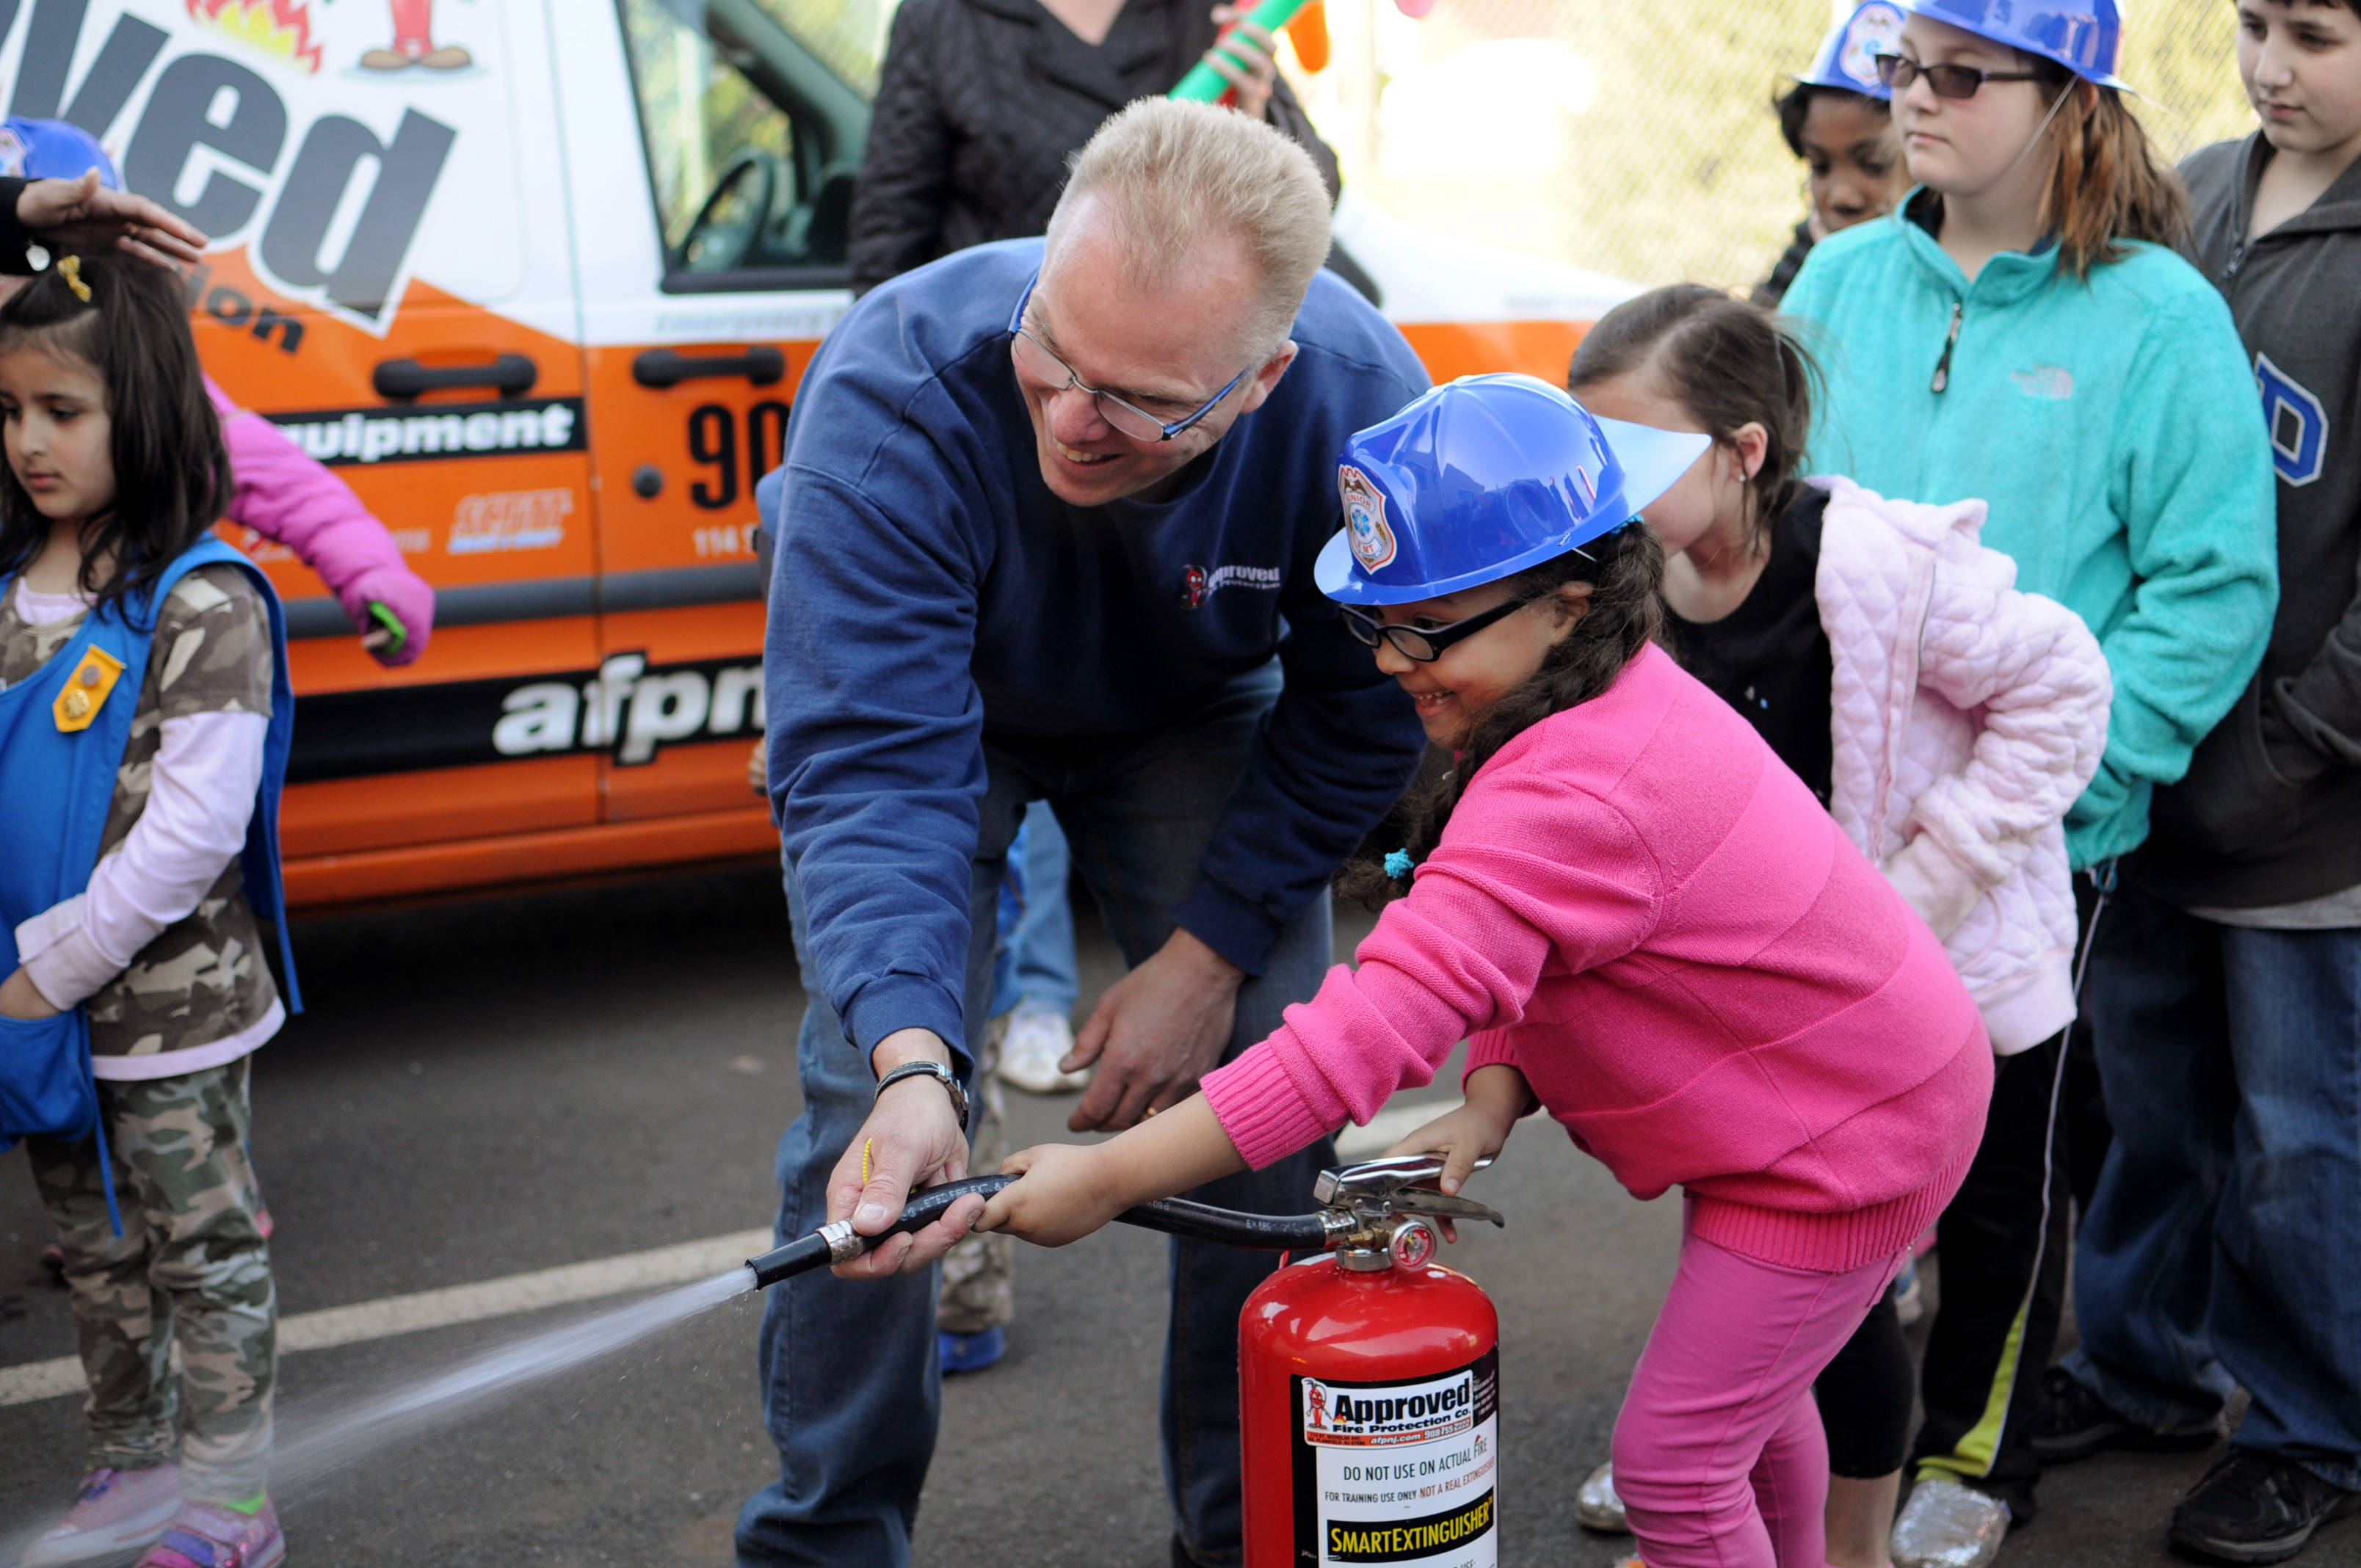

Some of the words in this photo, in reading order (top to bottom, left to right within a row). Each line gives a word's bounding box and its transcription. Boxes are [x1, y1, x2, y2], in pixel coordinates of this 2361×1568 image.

[0, 0, 458, 320] ved
[176, 260, 305, 354] ion
[1332, 1377, 1470, 1424] Approved
[1332, 1424, 1364, 1434] Fire
[1369, 1415, 1451, 1433] Protection
[1454, 1408, 1471, 1418] Co.
[1343, 1467, 1361, 1481] DO
[1366, 1466, 1390, 1481] NOT
[1394, 1463, 1415, 1480] USE
[1419, 1459, 1435, 1476] ON
[1438, 1448, 1472, 1473] ACTUAL
[1473, 1437, 1488, 1459] FIRE
[1370, 1432, 1421, 1445] afpnj.com
[1325, 1491, 1340, 1502] FOR
[1342, 1492, 1378, 1503] TRAINING
[1380, 1492, 1396, 1502] USE
[1397, 1490, 1418, 1501] ONLY
[1419, 1485, 1435, 1498] NOT
[1437, 1484, 1443, 1495] A
[1445, 1478, 1462, 1492] REAL
